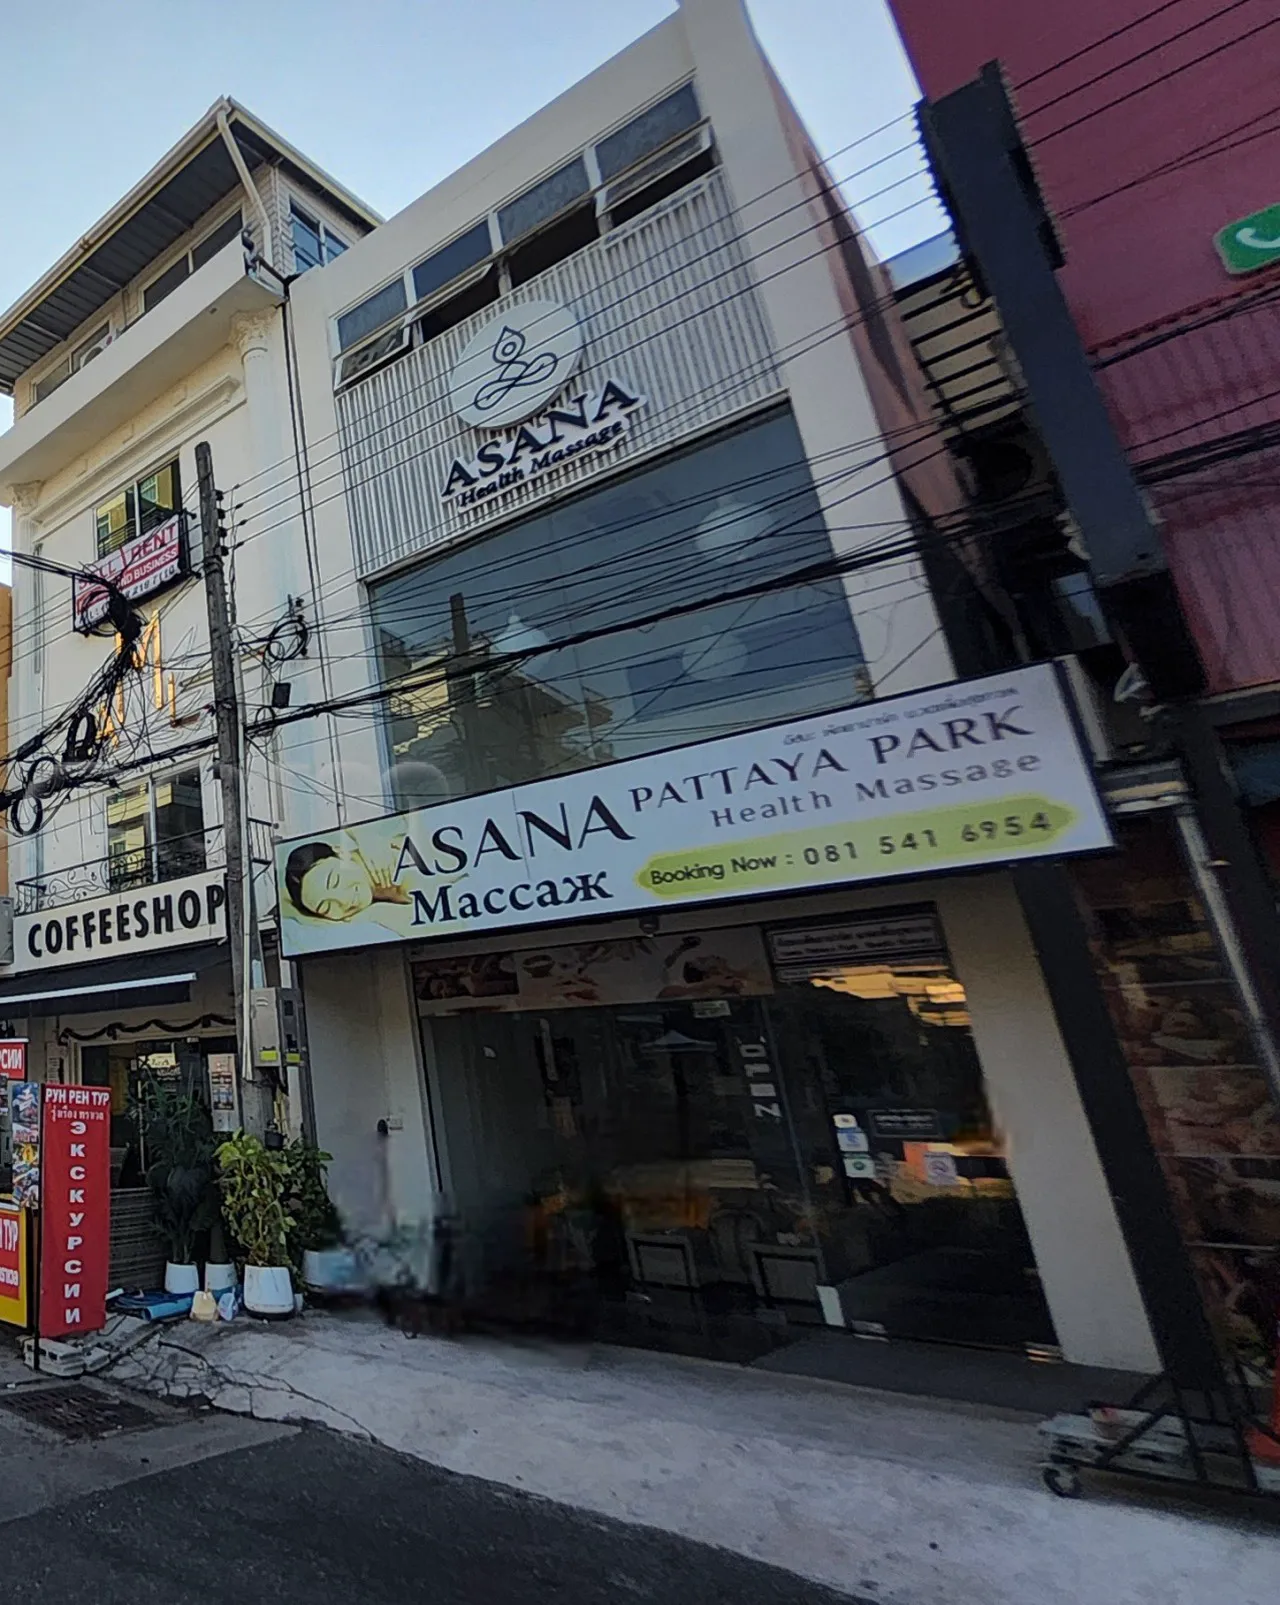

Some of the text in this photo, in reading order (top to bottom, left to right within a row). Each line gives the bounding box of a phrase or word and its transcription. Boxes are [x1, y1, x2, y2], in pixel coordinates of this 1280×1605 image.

[441, 379, 640, 498] ASANA
[456, 420, 623, 508] Health Massage
[134, 548, 177, 579] BUSINESS
[393, 705, 1036, 883] ASANA PATTAYA PARK
[709, 753, 1043, 828] Health Massage
[651, 860, 725, 886] Booking
[731, 853, 777, 874] Now
[803, 840, 859, 867] 081
[879, 829, 939, 856] 541
[960, 812, 1053, 844] 6954
[28, 884, 225, 959] COFFEESHOP
[410, 871, 614, 927] Массаж
[45, 1087, 110, 1107] РУН РЕН ТУР
[3, 1219, 19, 1252] ТУР
[64, 1121, 87, 1324] ЭКСКУРСИИ
